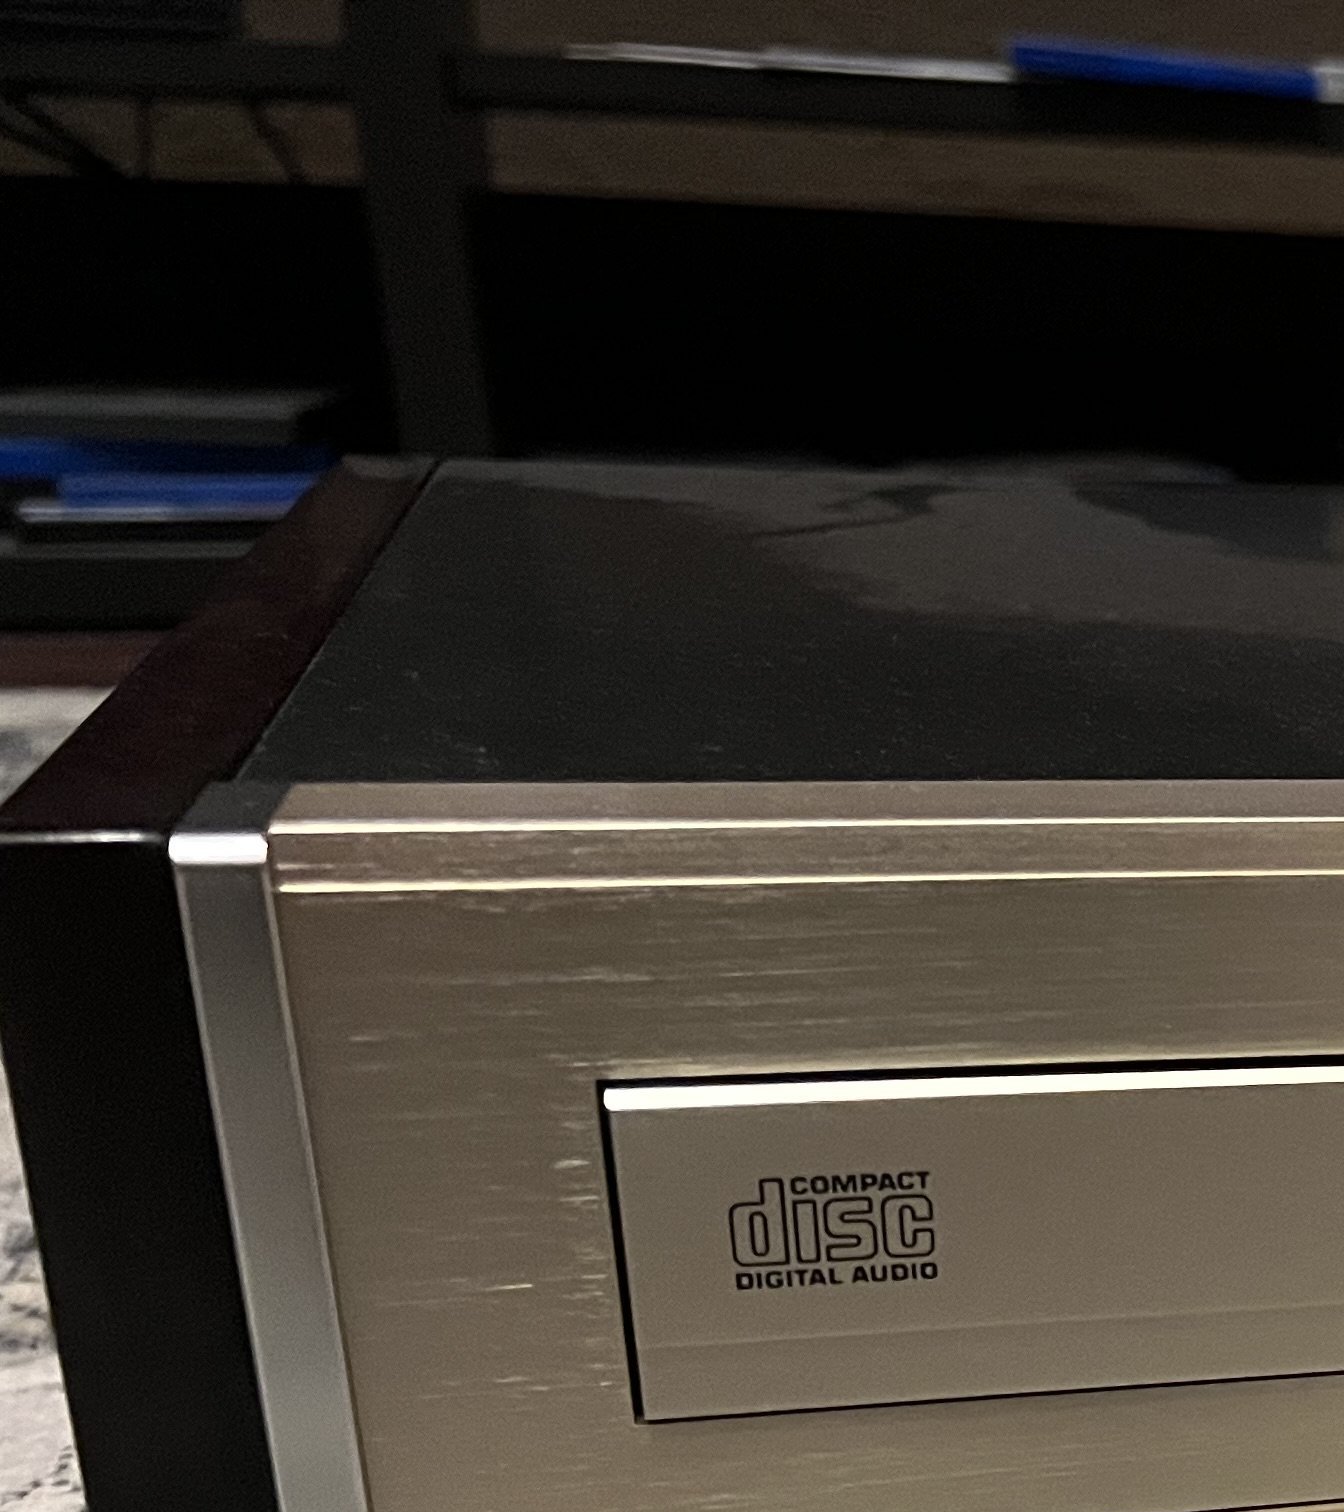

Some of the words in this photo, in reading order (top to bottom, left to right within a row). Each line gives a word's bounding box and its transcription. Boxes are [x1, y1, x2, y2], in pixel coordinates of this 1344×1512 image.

[790, 1171, 930, 1195] COMPACT
[728, 1177, 935, 1267] disc
[735, 1268, 844, 1290] DIGITAL
[852, 1262, 938, 1284] AUDIO
